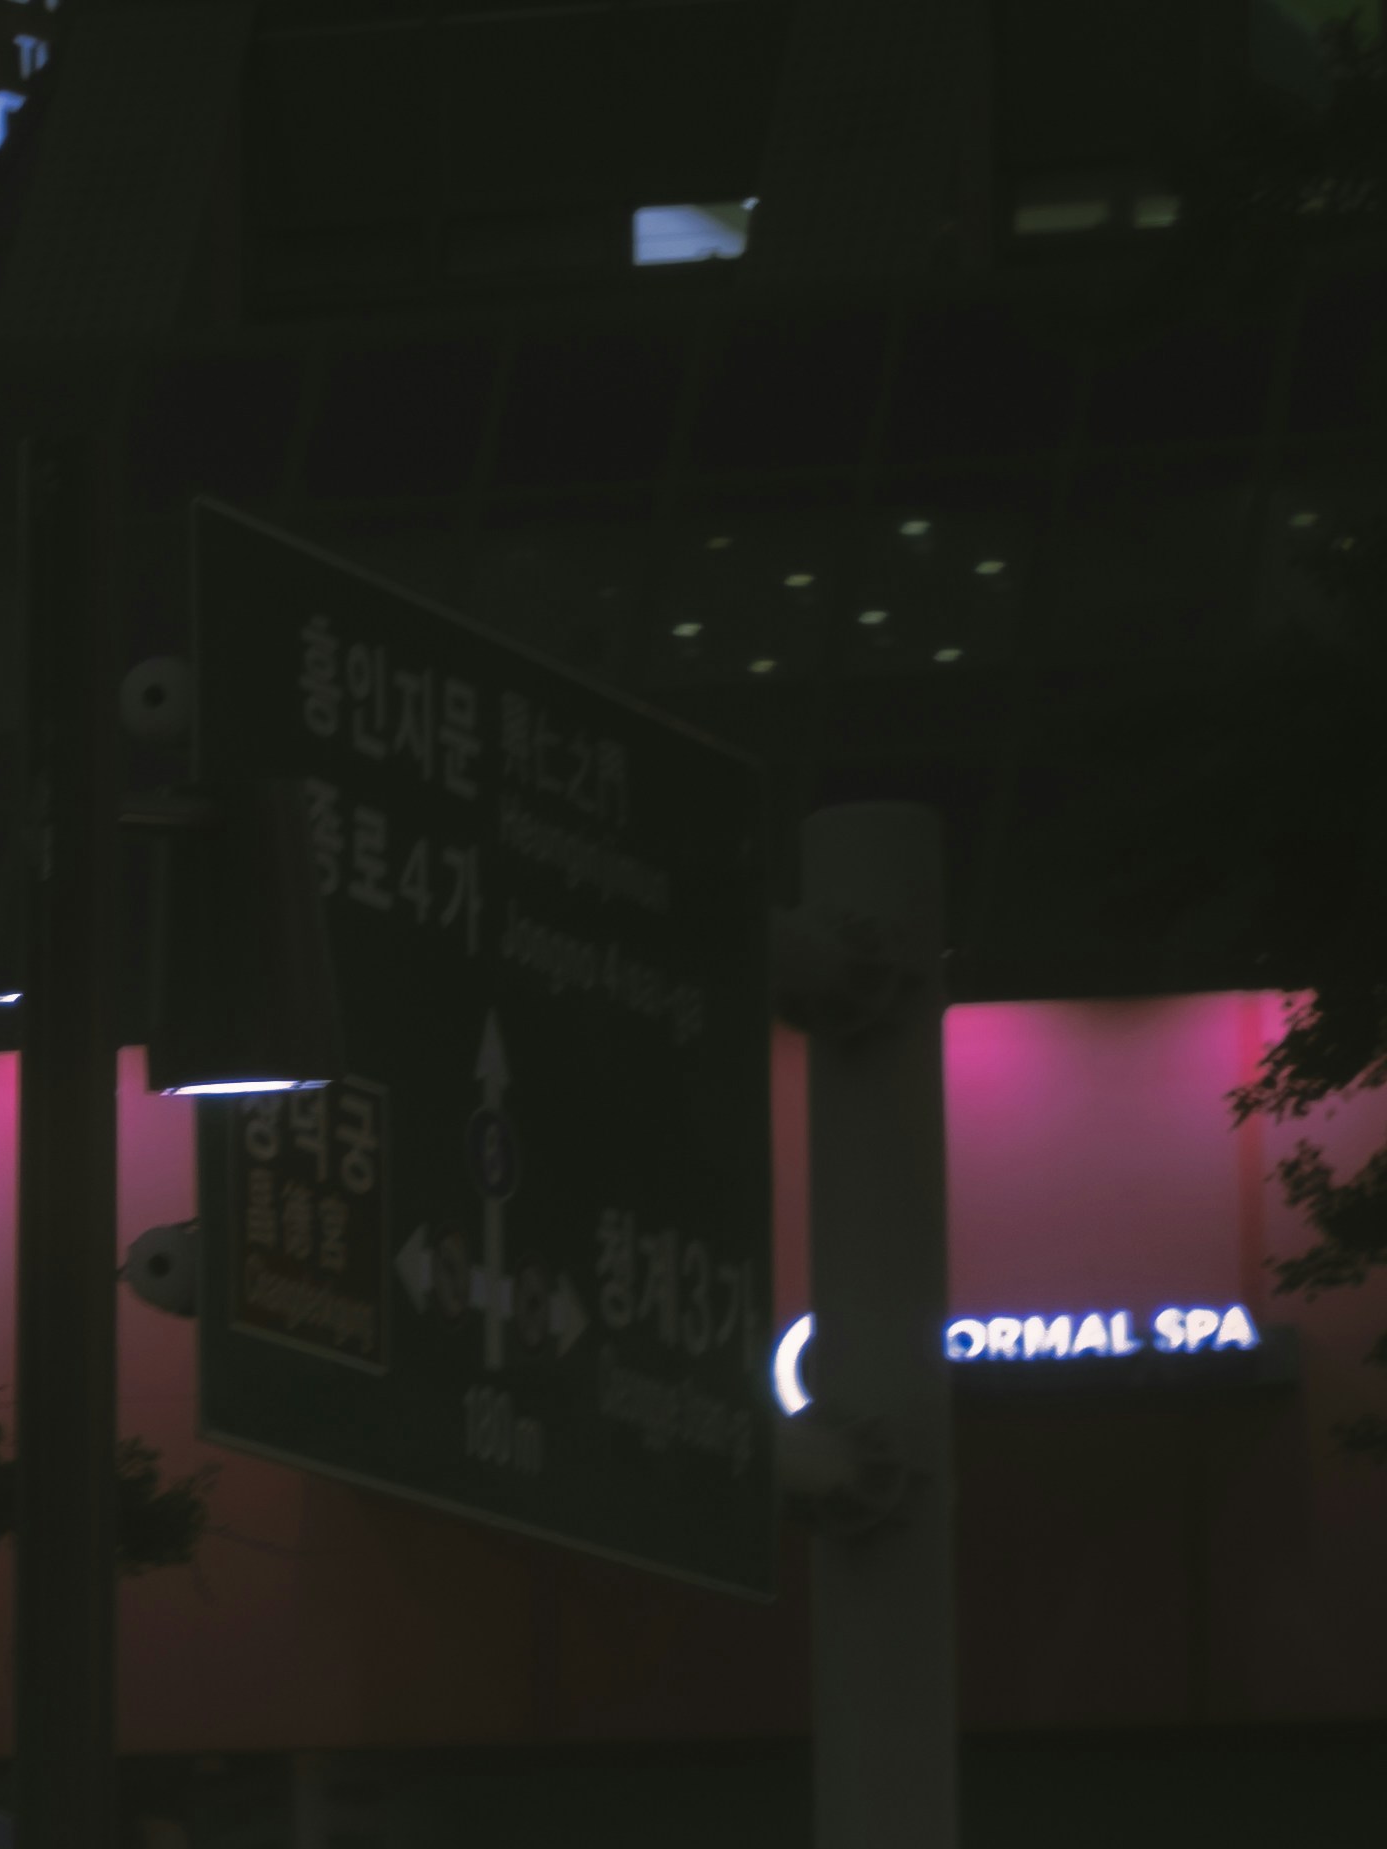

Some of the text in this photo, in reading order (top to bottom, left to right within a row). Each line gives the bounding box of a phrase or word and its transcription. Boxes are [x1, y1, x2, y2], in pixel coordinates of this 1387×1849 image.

[299, 613, 482, 802] 흥인지문
[303, 776, 483, 958] 종로4가
[595, 1206, 759, 1374] 청계3가
[1153, 1304, 1258, 1352] SPA
